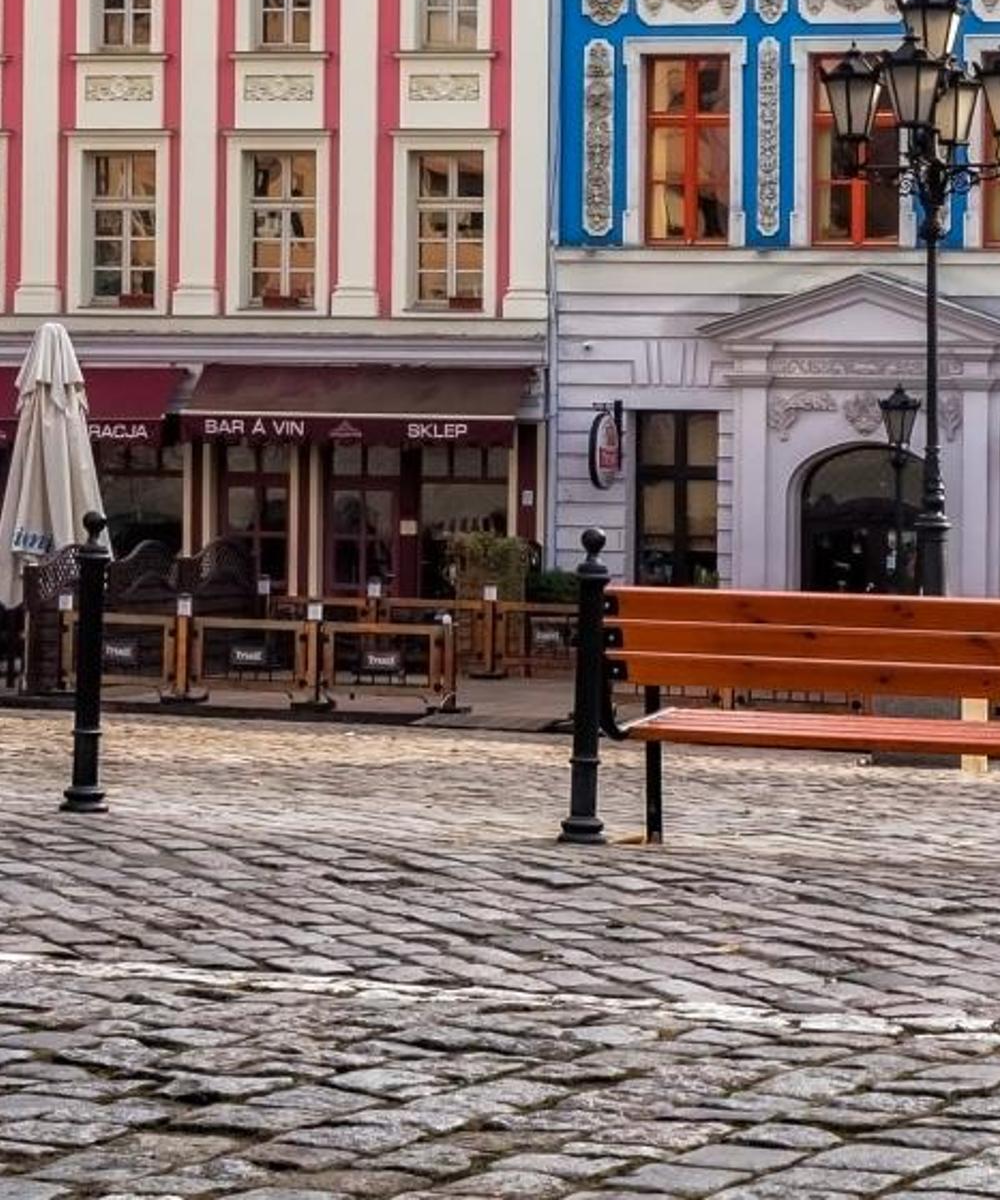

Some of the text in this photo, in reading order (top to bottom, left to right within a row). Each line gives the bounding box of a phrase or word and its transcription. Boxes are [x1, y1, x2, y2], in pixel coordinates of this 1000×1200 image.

[204, 419, 244, 434] BAR
[272, 420, 304, 436] VIN
[407, 423, 468, 438] SKLEP
